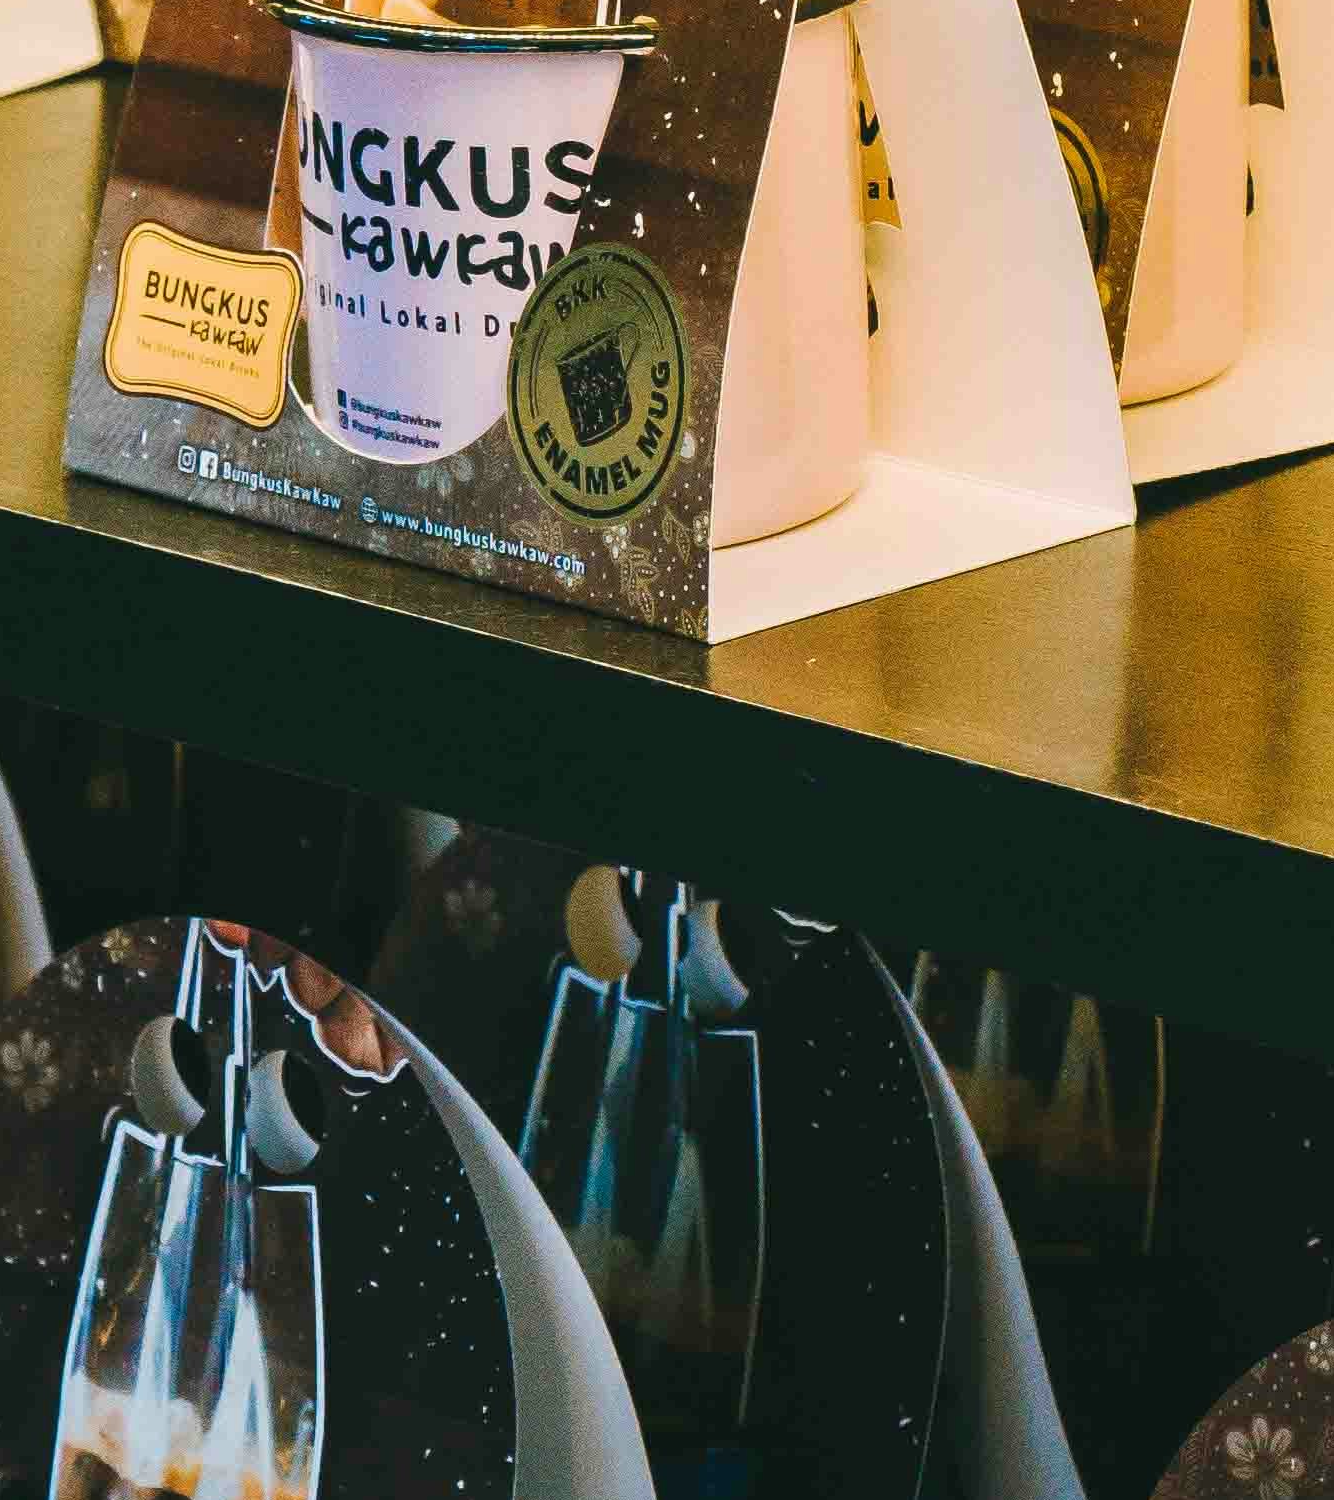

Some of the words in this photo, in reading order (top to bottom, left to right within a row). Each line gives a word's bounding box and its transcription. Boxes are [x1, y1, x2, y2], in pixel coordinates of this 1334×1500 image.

[144, 269, 270, 328] BUNGKUS
[380, 300, 462, 335] Lokal
[555, 275, 608, 322] BKK
[532, 420, 642, 498] ENAMEL
[636, 359, 672, 457] MUG
[222, 461, 342, 512] BungkusKawKaw
[382, 509, 587, 577] www.bungkuskawkaw.com
